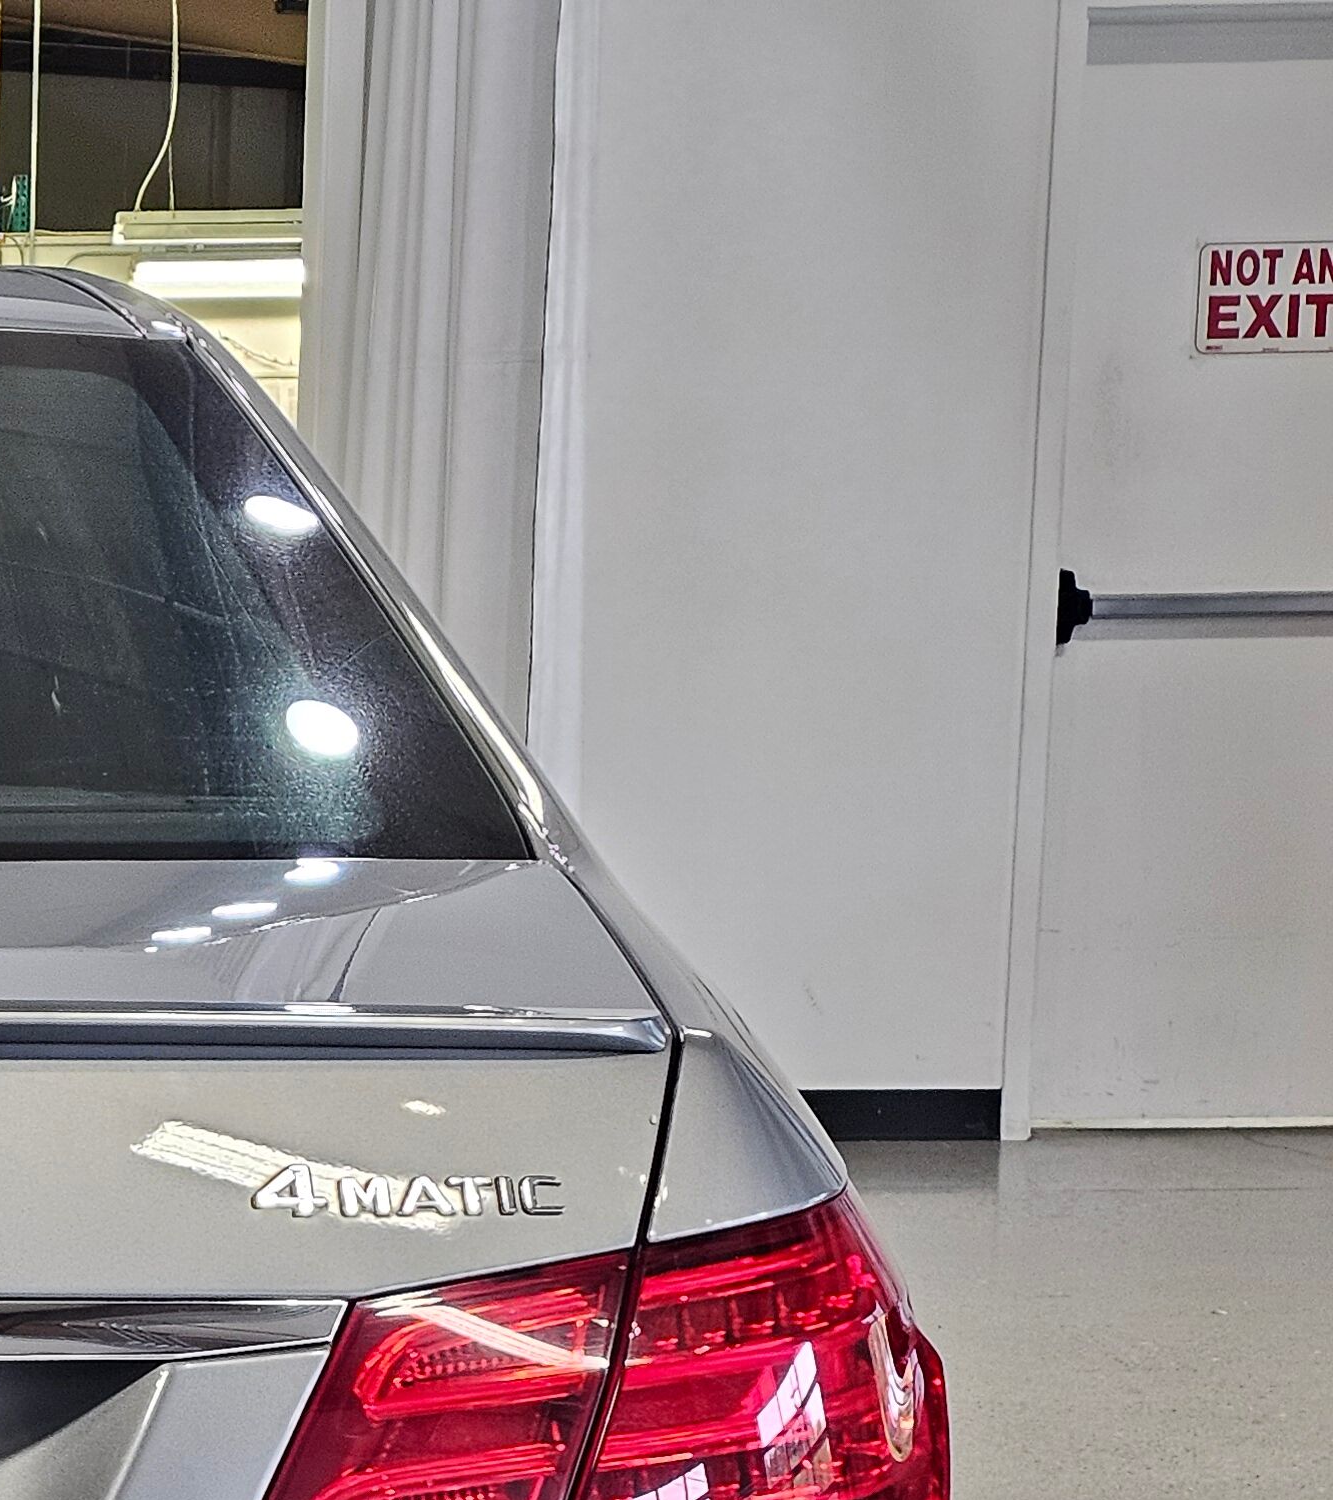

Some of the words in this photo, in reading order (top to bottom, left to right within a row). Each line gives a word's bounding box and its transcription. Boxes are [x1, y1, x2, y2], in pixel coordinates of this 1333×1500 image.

[1209, 248, 1283, 286] NOT
[1291, 247, 1333, 285] AN
[1206, 293, 1333, 339] EXIT
